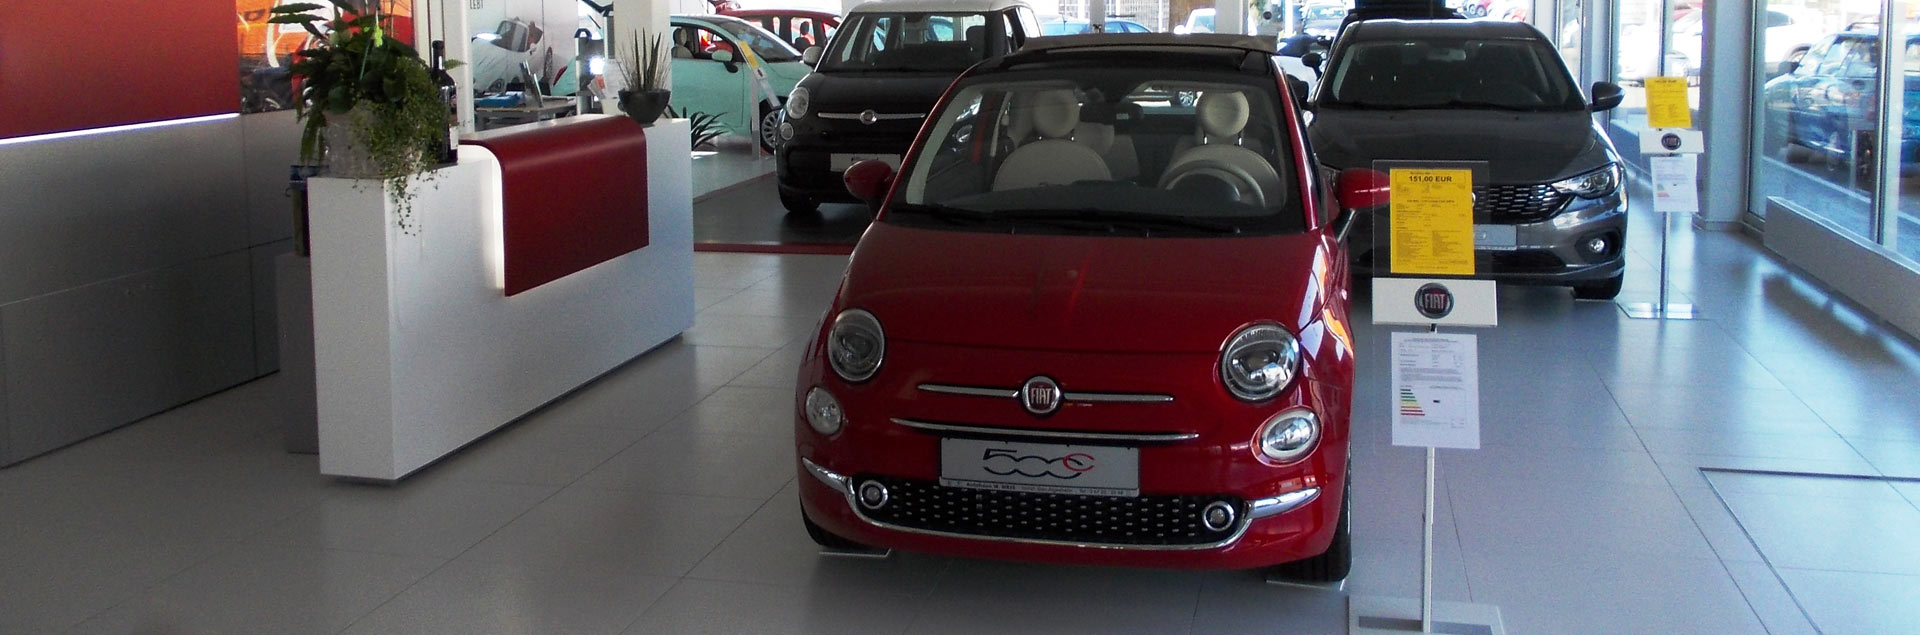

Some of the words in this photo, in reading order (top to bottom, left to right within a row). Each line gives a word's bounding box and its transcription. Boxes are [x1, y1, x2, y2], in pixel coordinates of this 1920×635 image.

[1435, 175, 1452, 183] EUR
[1424, 293, 1446, 309] FIAT
[1031, 387, 1052, 405] FIAT
